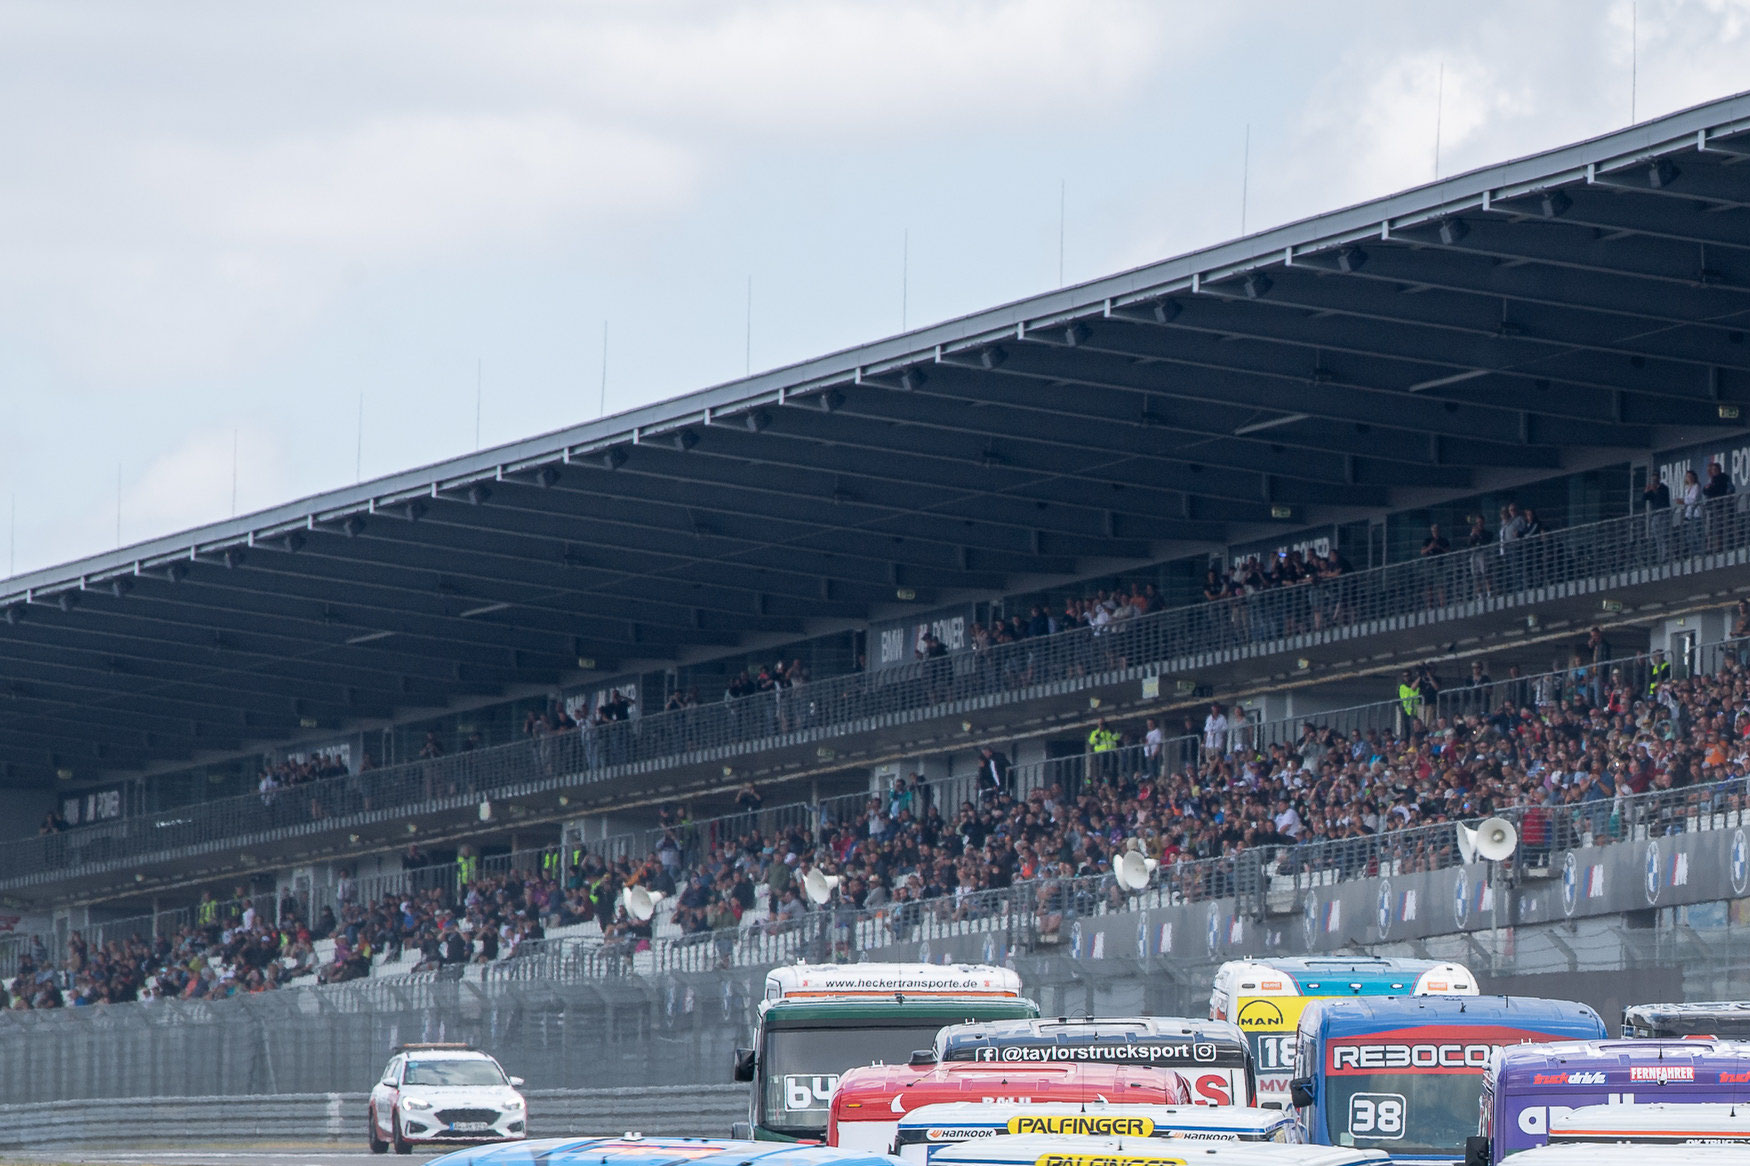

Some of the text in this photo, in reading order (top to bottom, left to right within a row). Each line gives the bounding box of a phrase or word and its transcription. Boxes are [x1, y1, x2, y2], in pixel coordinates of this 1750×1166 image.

[826, 978, 978, 990] www.heckertransporte.de
[1002, 1043, 1189, 1062] @taylorstrucksport
[1333, 1044, 1498, 1069] REBOCO
[1631, 1067, 1694, 1080] FERNFAHRER
[1352, 1100, 1402, 1132] 38
[1017, 1117, 1144, 1136] PALFINGER
